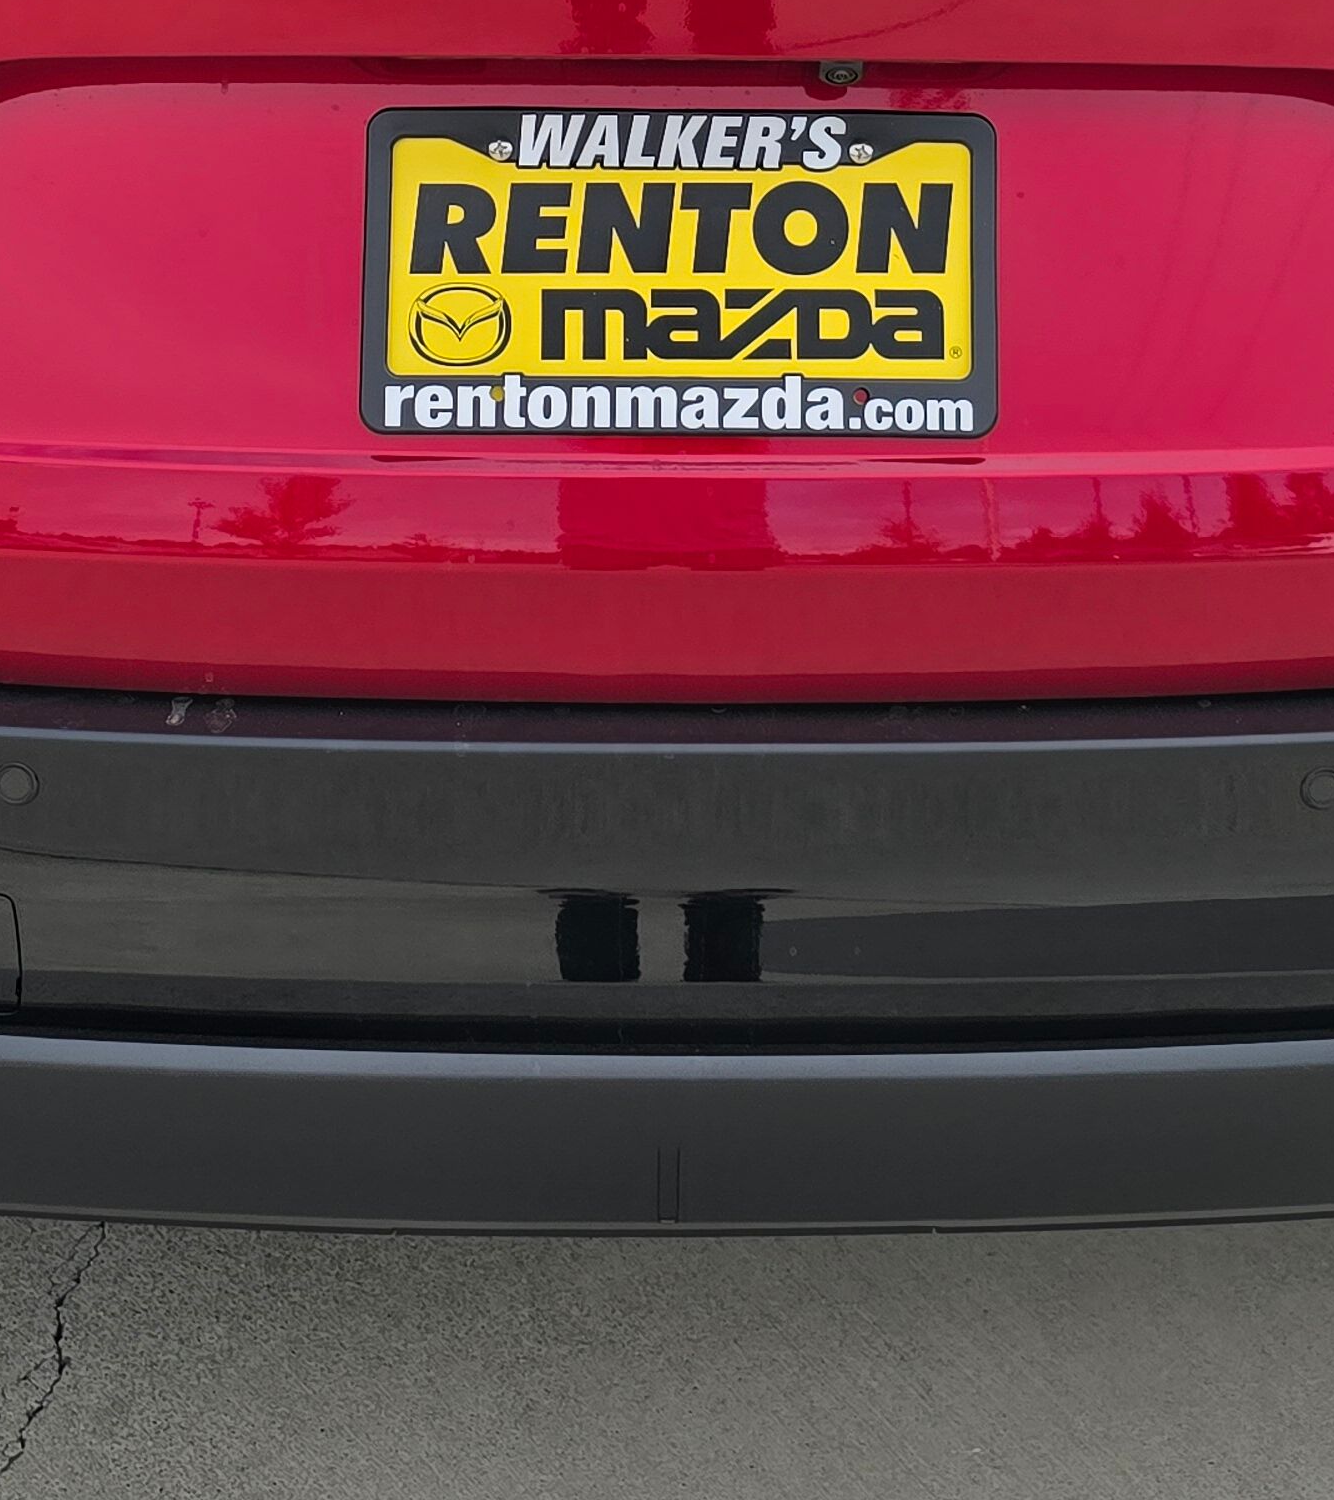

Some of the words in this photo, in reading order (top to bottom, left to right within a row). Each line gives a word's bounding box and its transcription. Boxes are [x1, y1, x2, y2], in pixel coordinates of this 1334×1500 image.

[517, 113, 848, 171] WALKER'S
[409, 182, 953, 276] RENTON
[383, 374, 974, 432] rentonmazda.com
